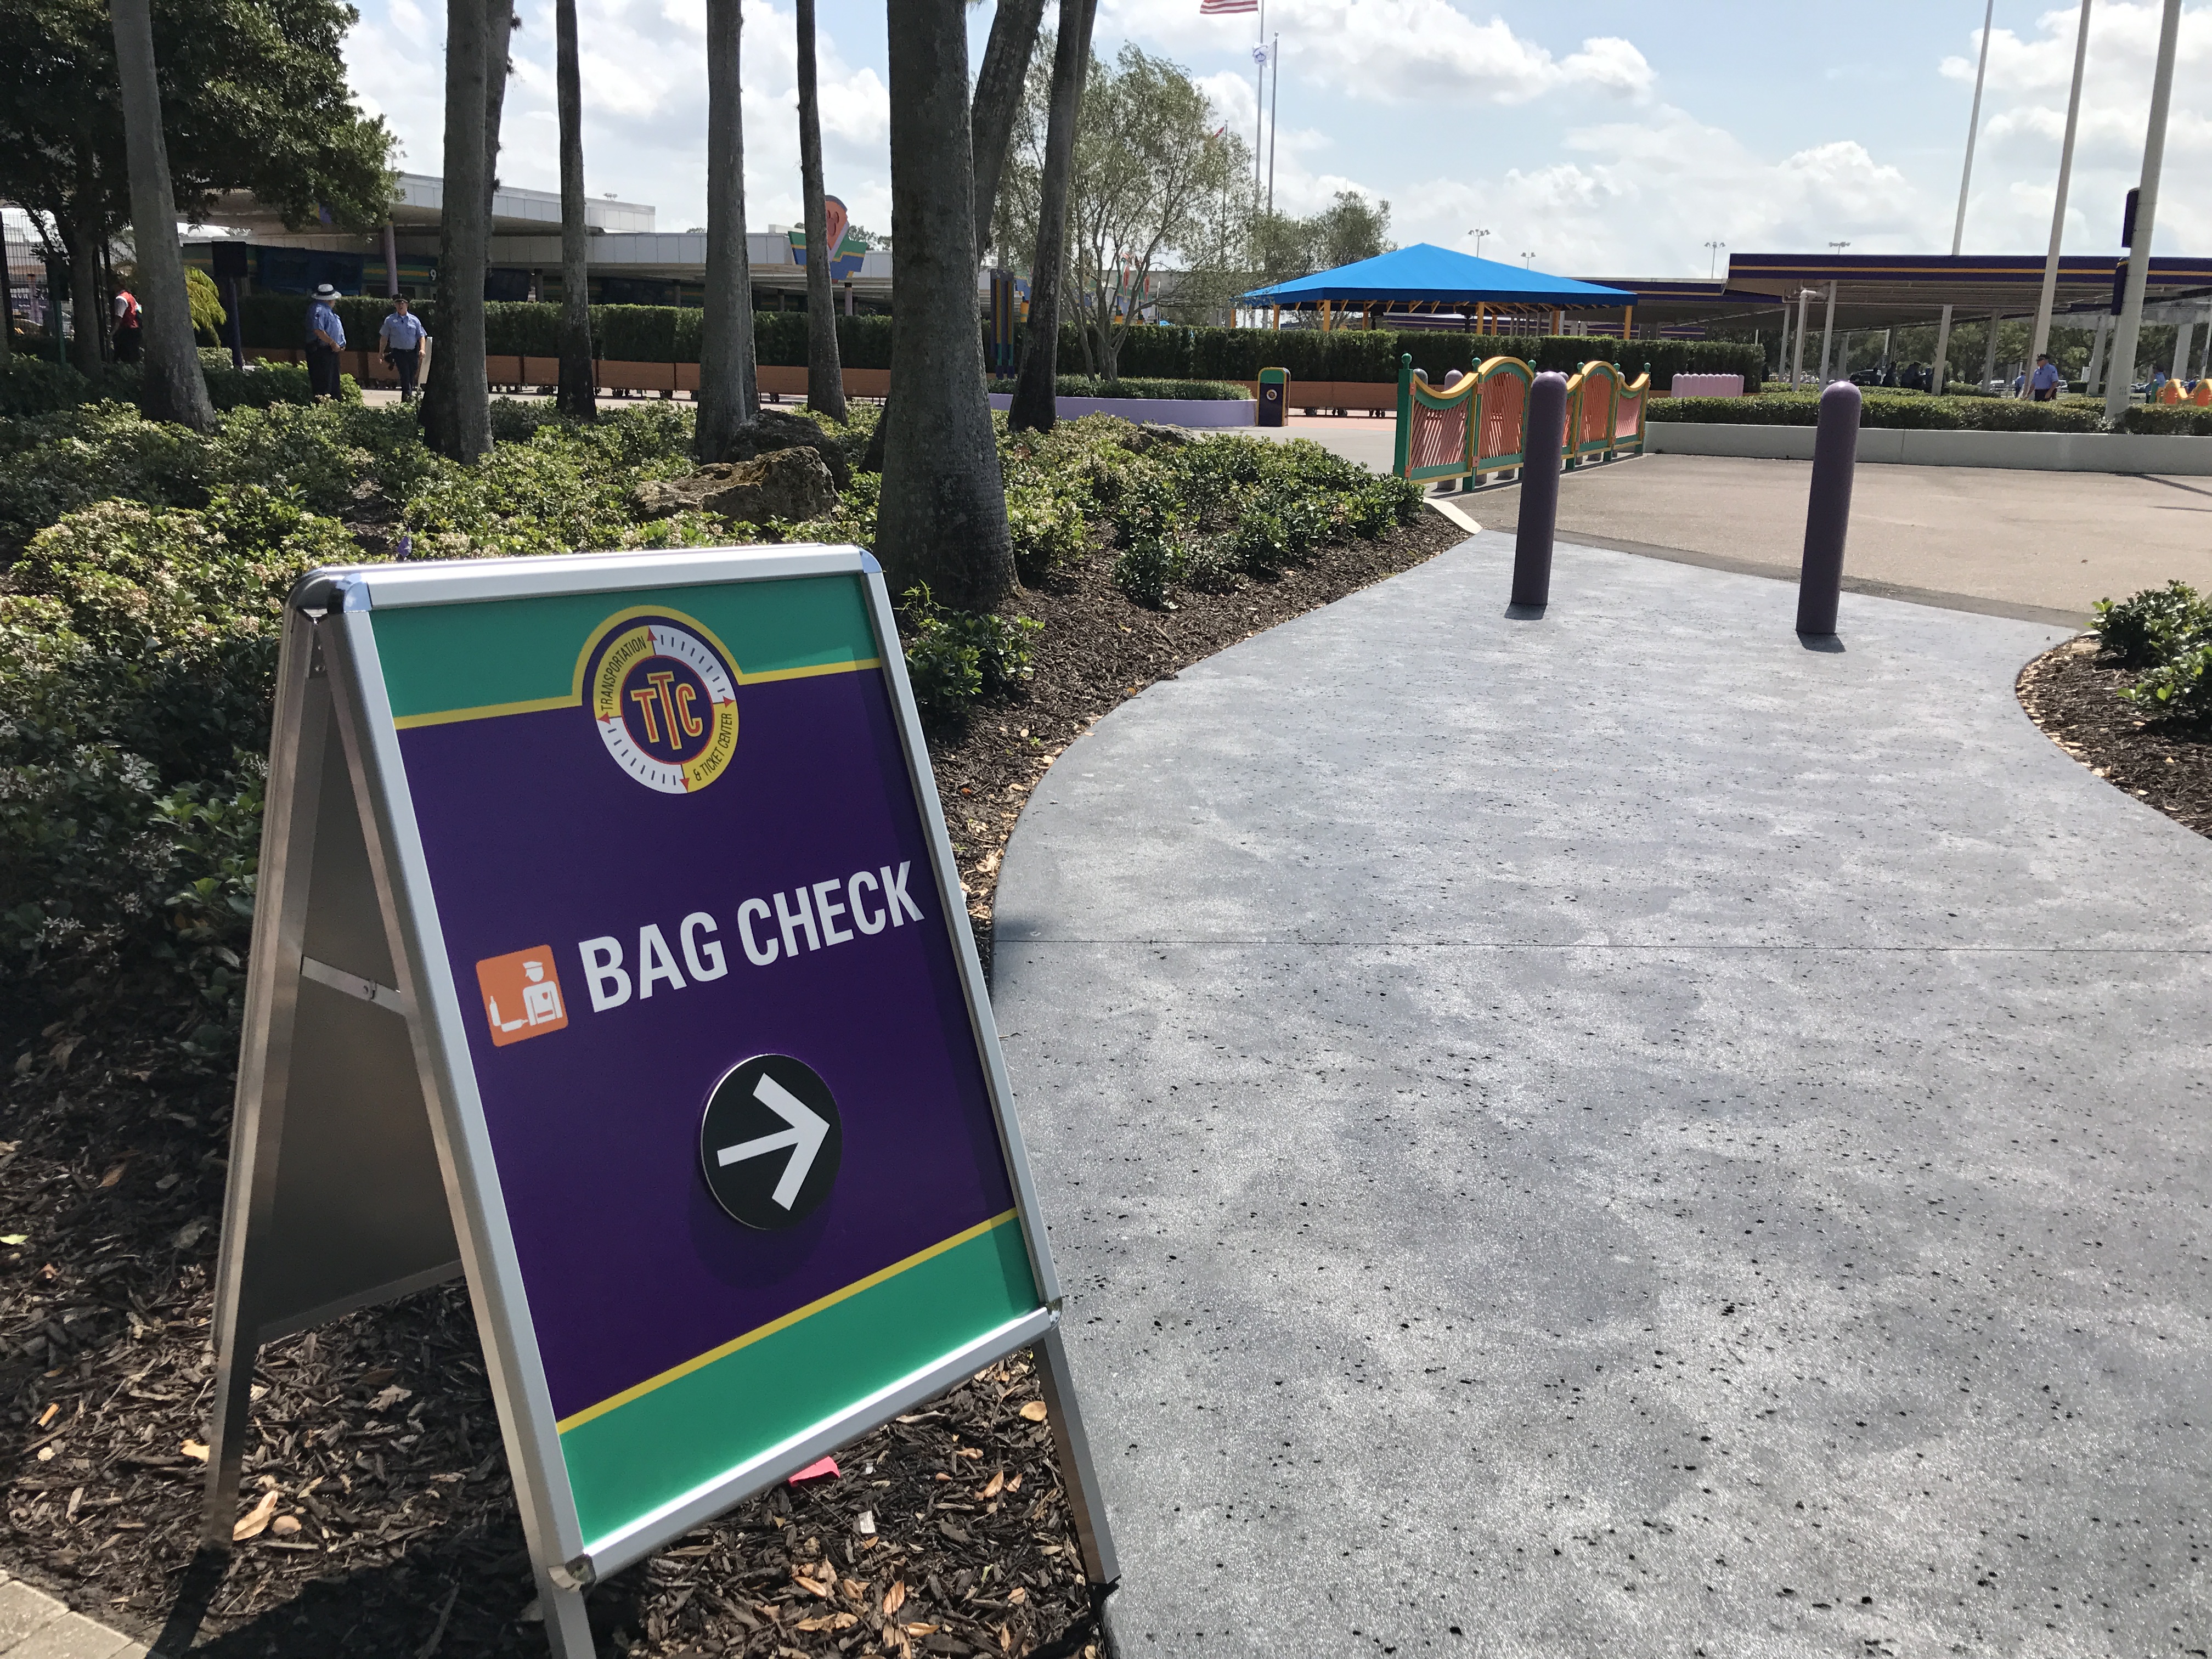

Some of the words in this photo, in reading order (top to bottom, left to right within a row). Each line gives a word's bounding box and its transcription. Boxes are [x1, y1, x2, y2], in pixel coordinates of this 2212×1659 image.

[430, 269, 437, 281] 9
[601, 635, 647, 711] TRANSPORTATION
[631, 671, 703, 750] TTC
[693, 769, 702, 781] &
[699, 747, 725, 776] TICKET
[718, 713, 732, 749] CENTER
[578, 911, 728, 1013] BAG
[737, 861, 925, 966] CHECK
